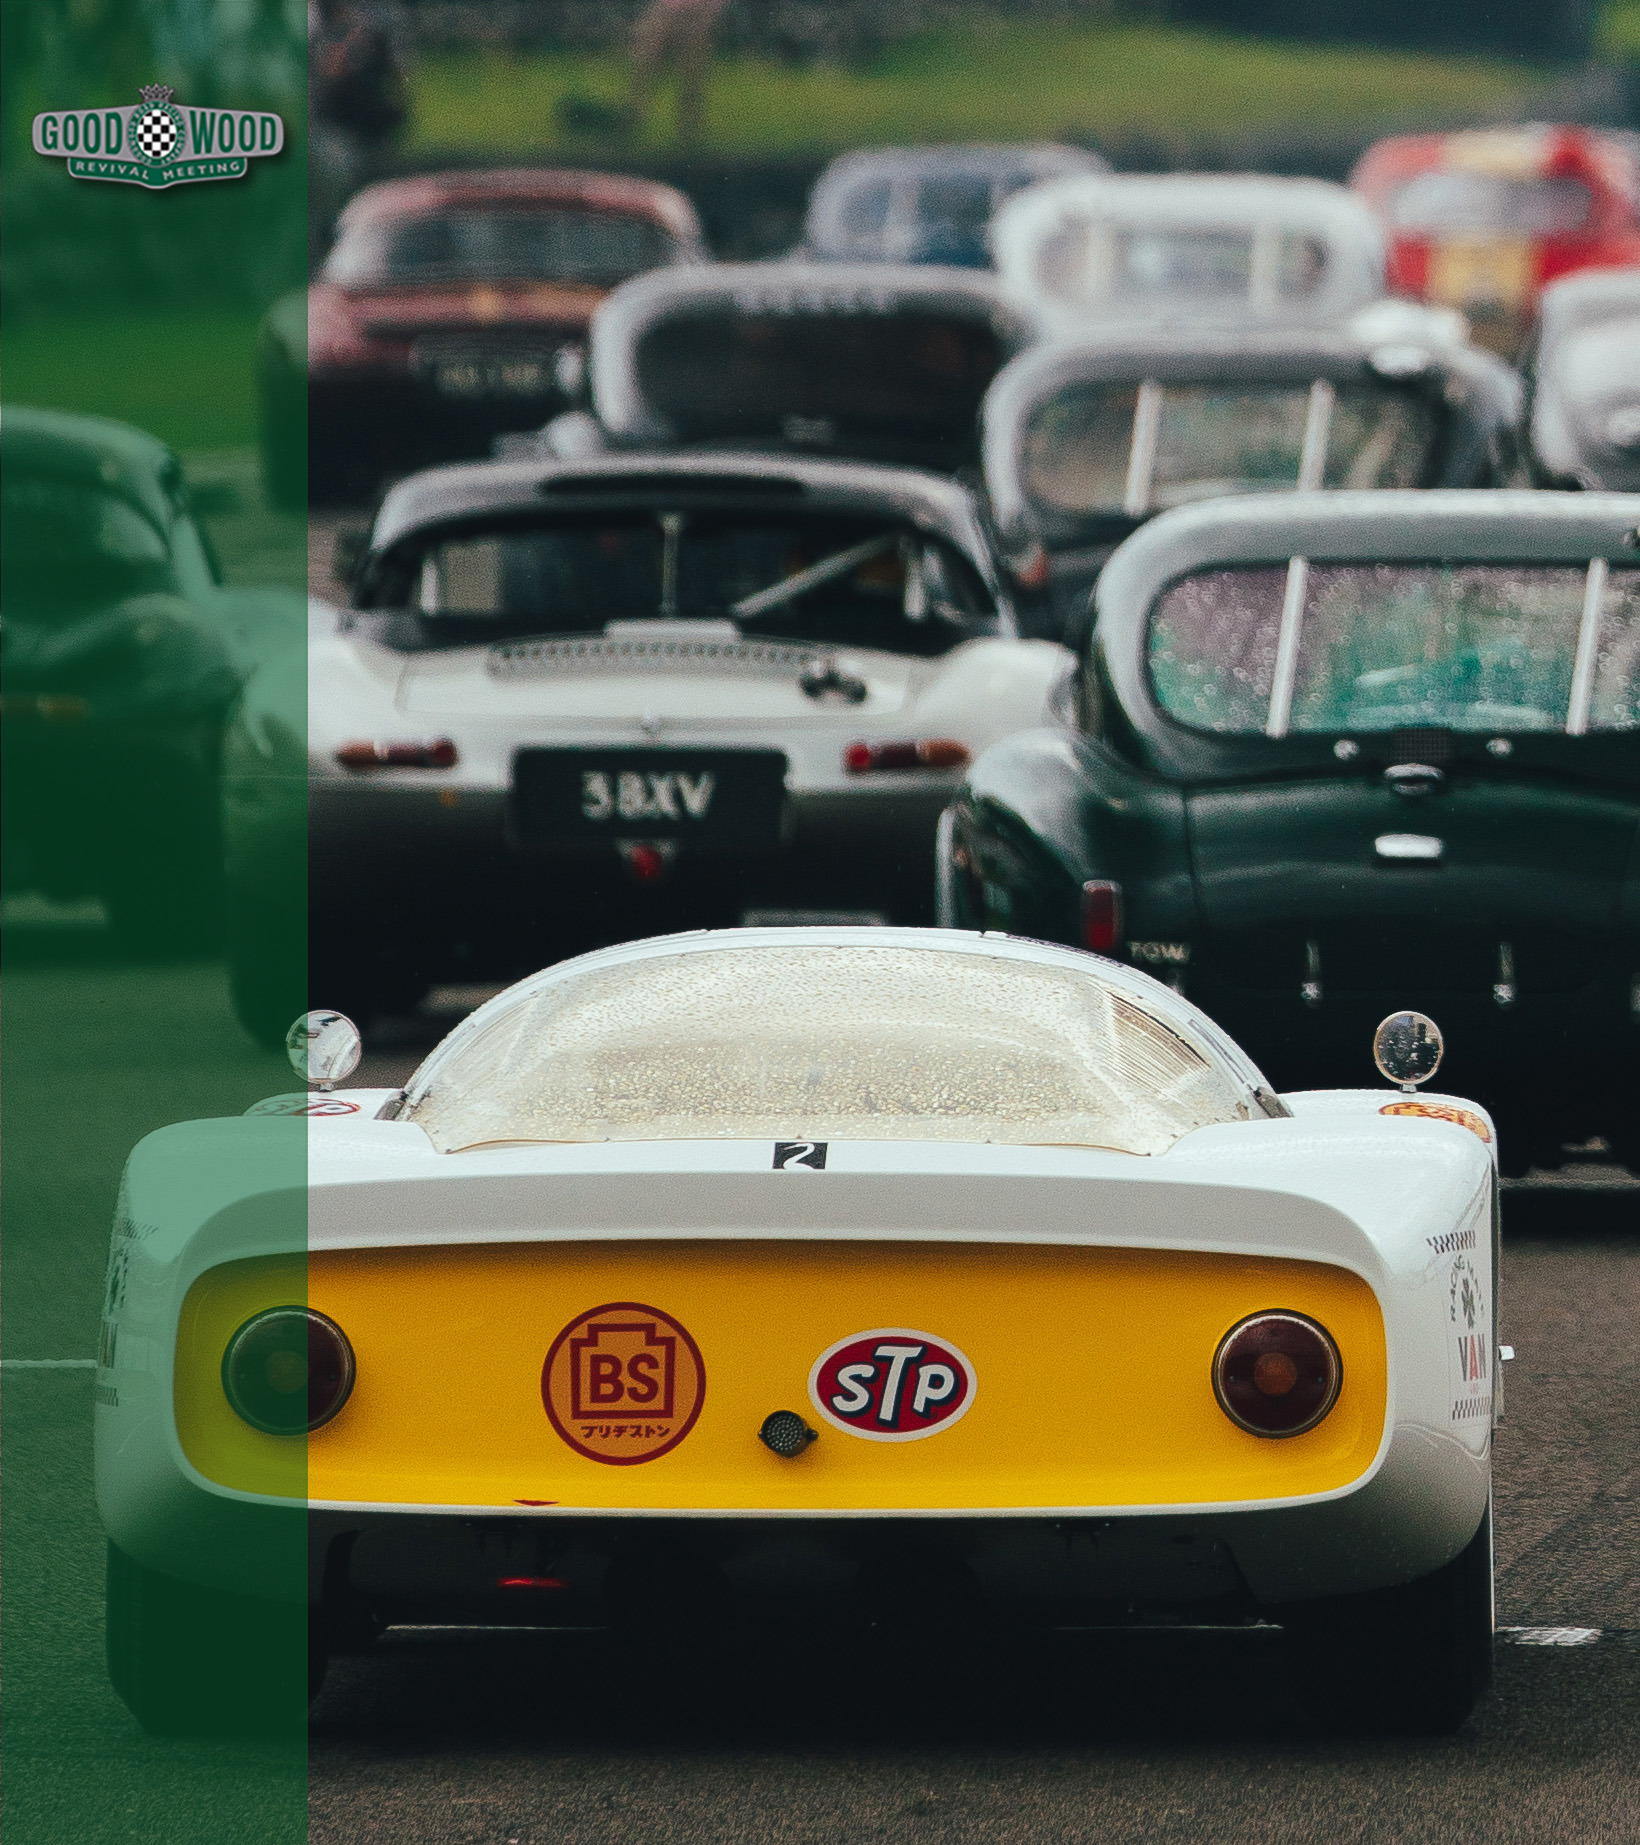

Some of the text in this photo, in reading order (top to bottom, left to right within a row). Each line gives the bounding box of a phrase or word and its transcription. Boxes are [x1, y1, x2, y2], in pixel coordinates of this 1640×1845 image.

[1128, 941, 1190, 963] TOW
[783, 1142, 817, 1170] 2
[589, 1352, 660, 1404] BS
[831, 1345, 957, 1425] STP
